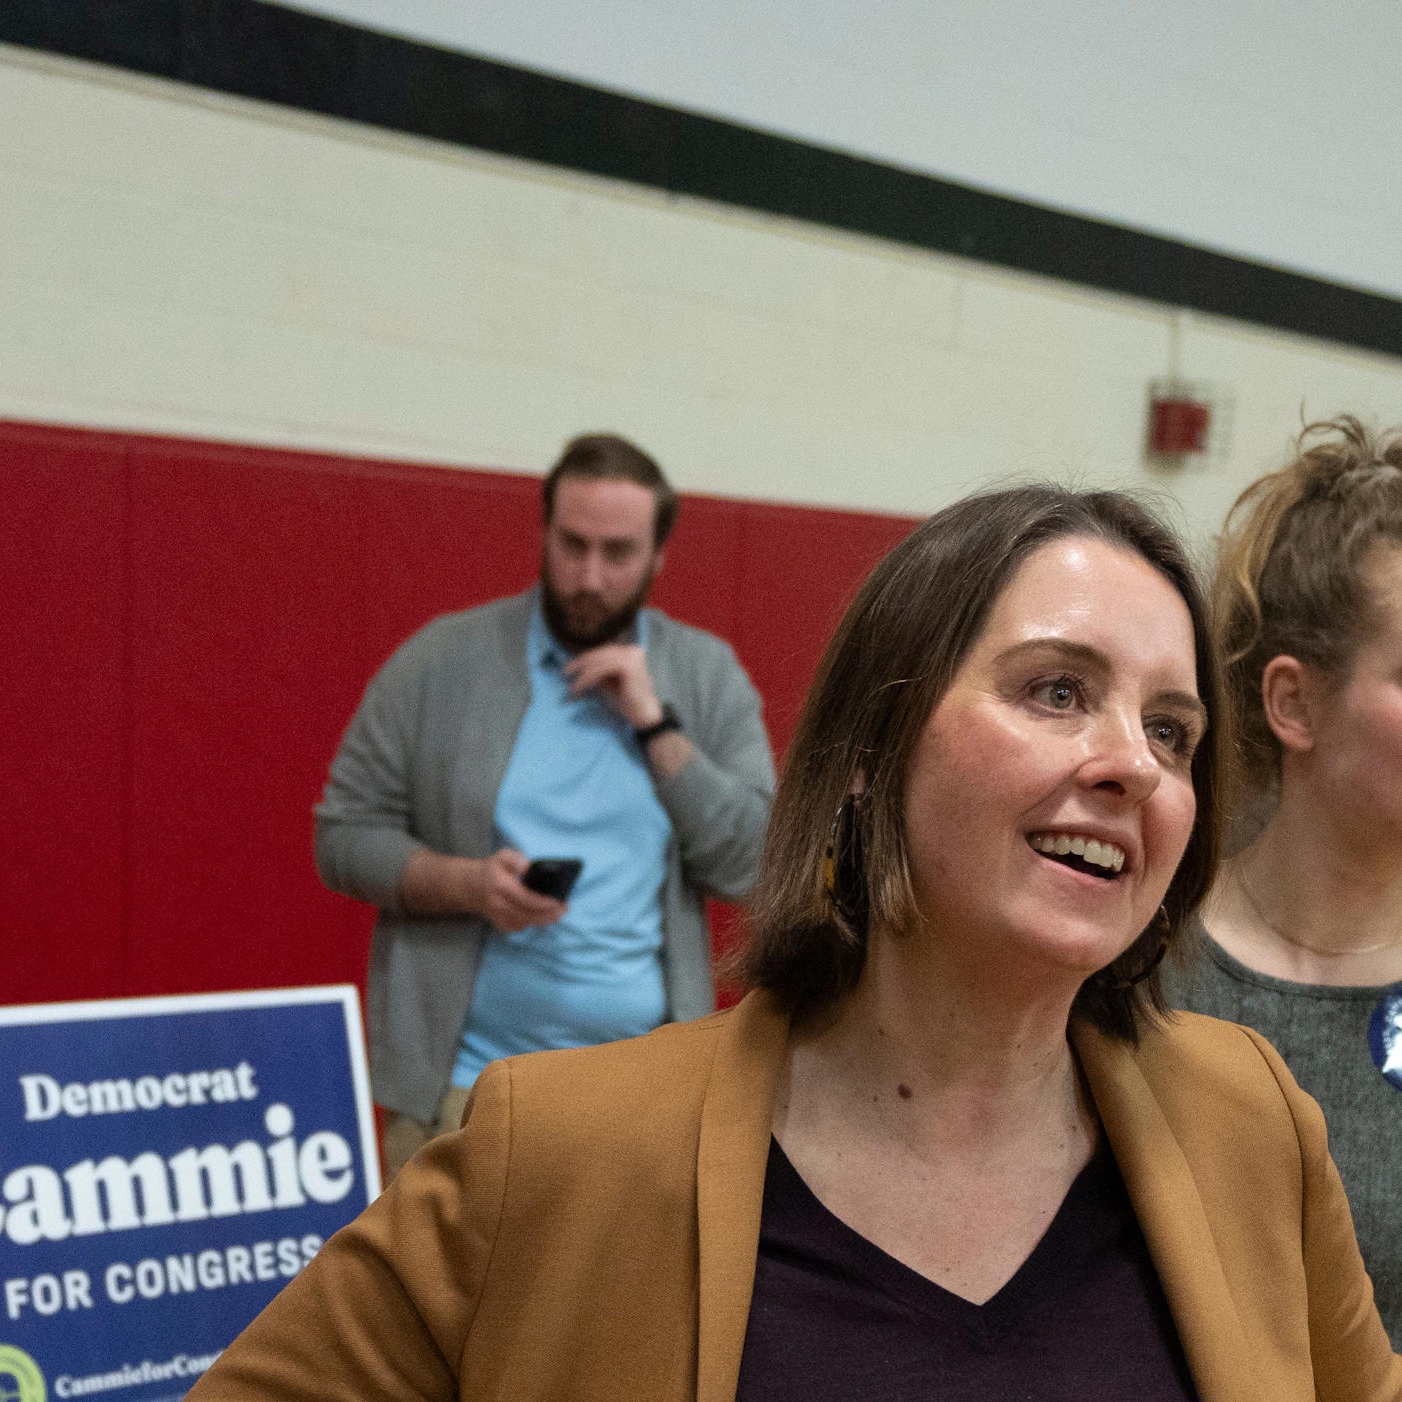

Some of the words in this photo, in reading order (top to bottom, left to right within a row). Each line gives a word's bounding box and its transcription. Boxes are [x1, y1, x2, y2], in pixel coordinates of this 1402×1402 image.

[19, 1061, 258, 1121] Democrat
[4, 1269, 93, 1319] FOR
[105, 1234, 325, 1303] CONGRESS
